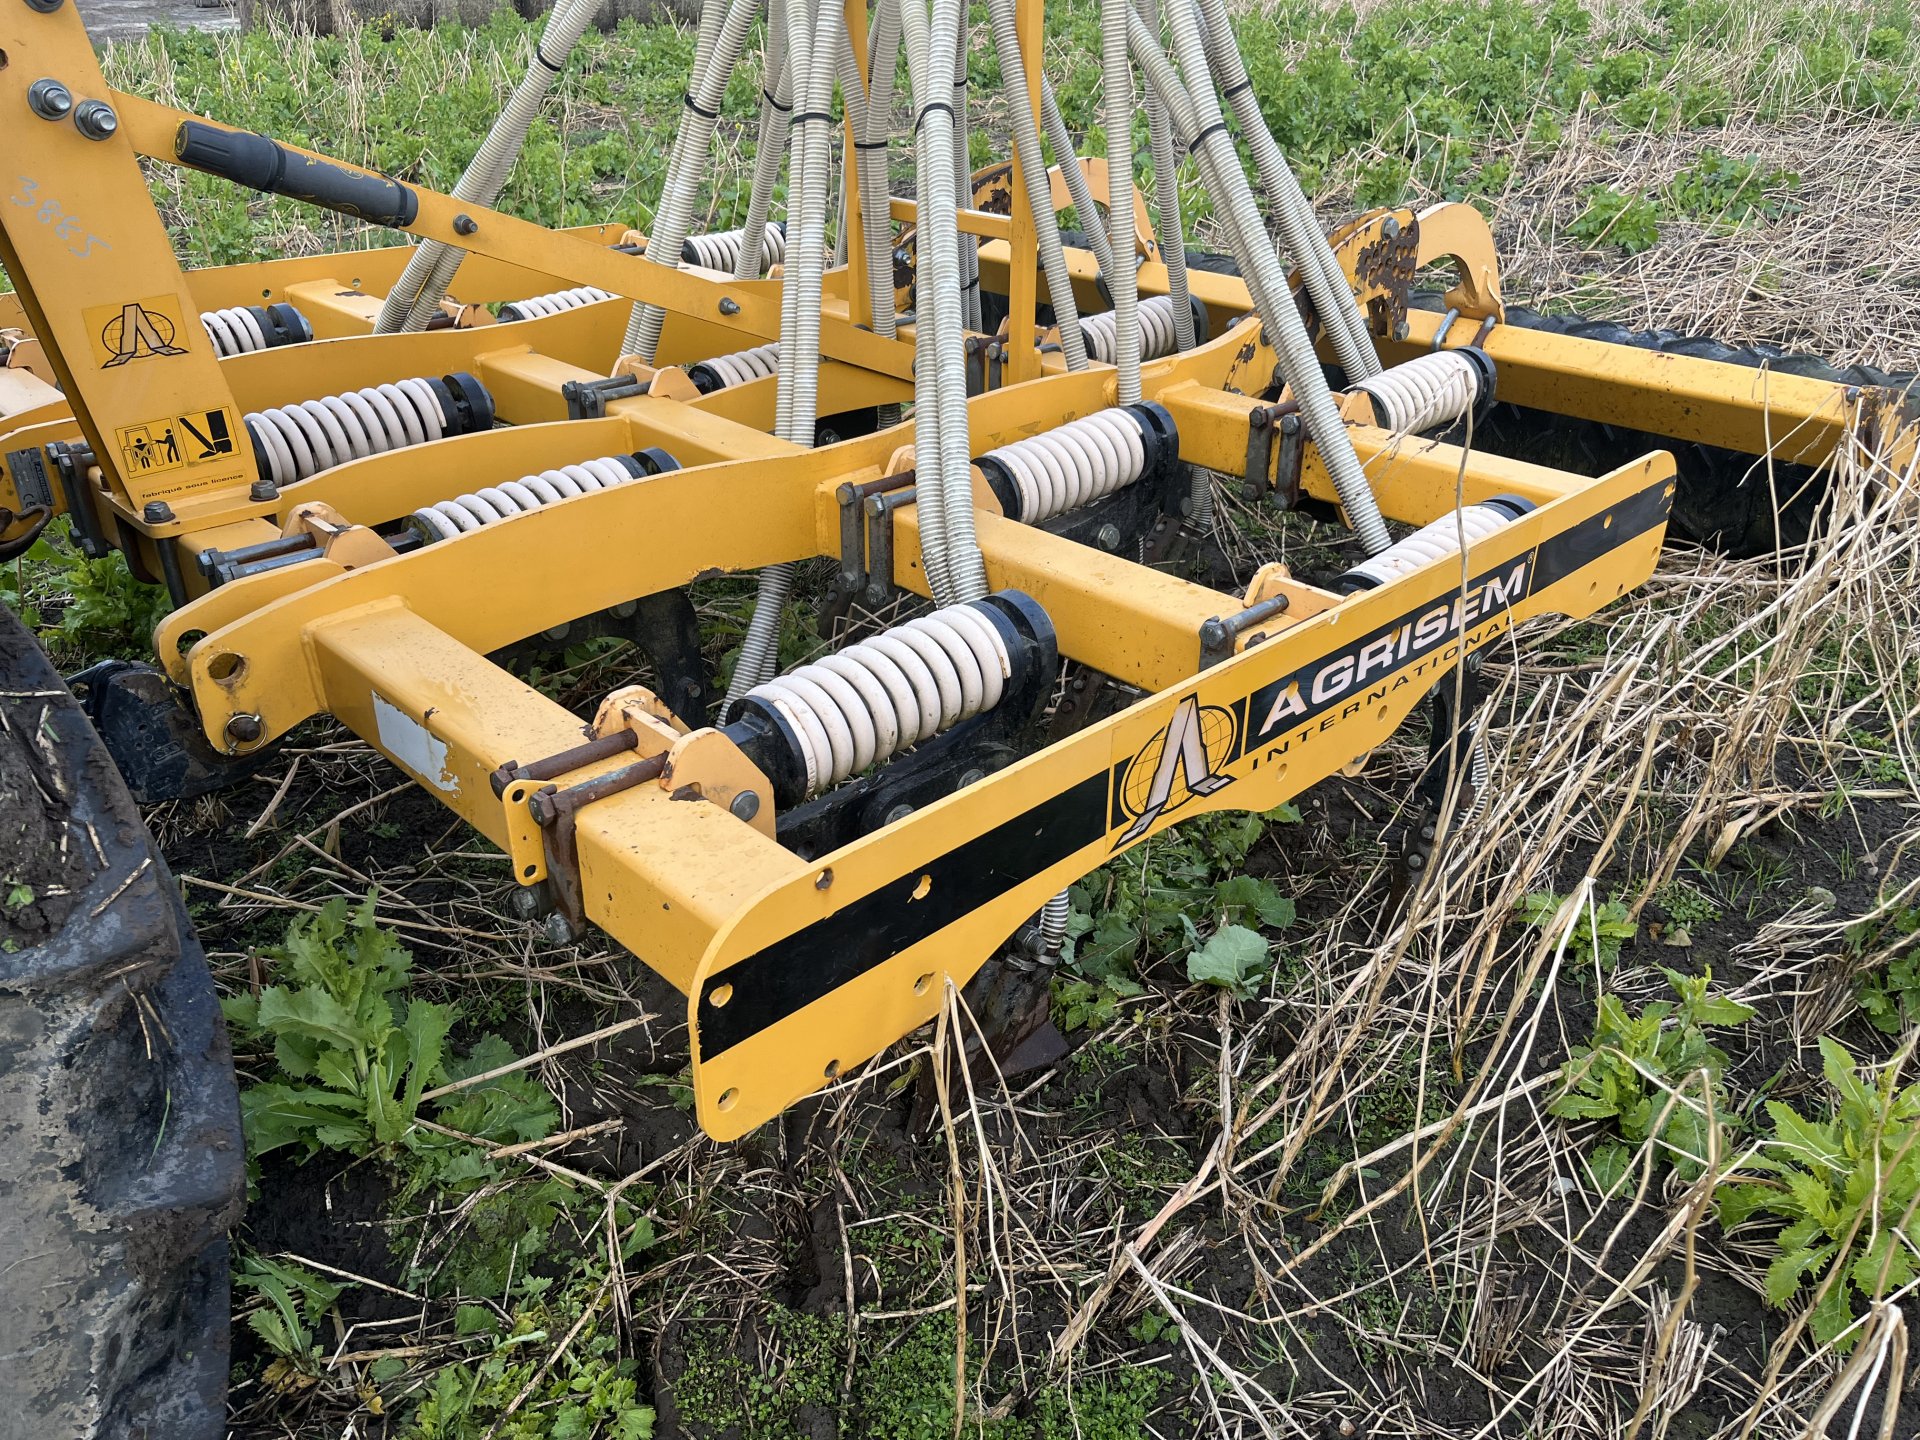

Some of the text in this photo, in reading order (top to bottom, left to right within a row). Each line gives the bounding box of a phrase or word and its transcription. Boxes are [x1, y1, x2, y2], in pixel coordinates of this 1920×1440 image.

[142, 474, 244, 499] fabriqué sous licence
[1258, 562, 1526, 737] AGRISEM
